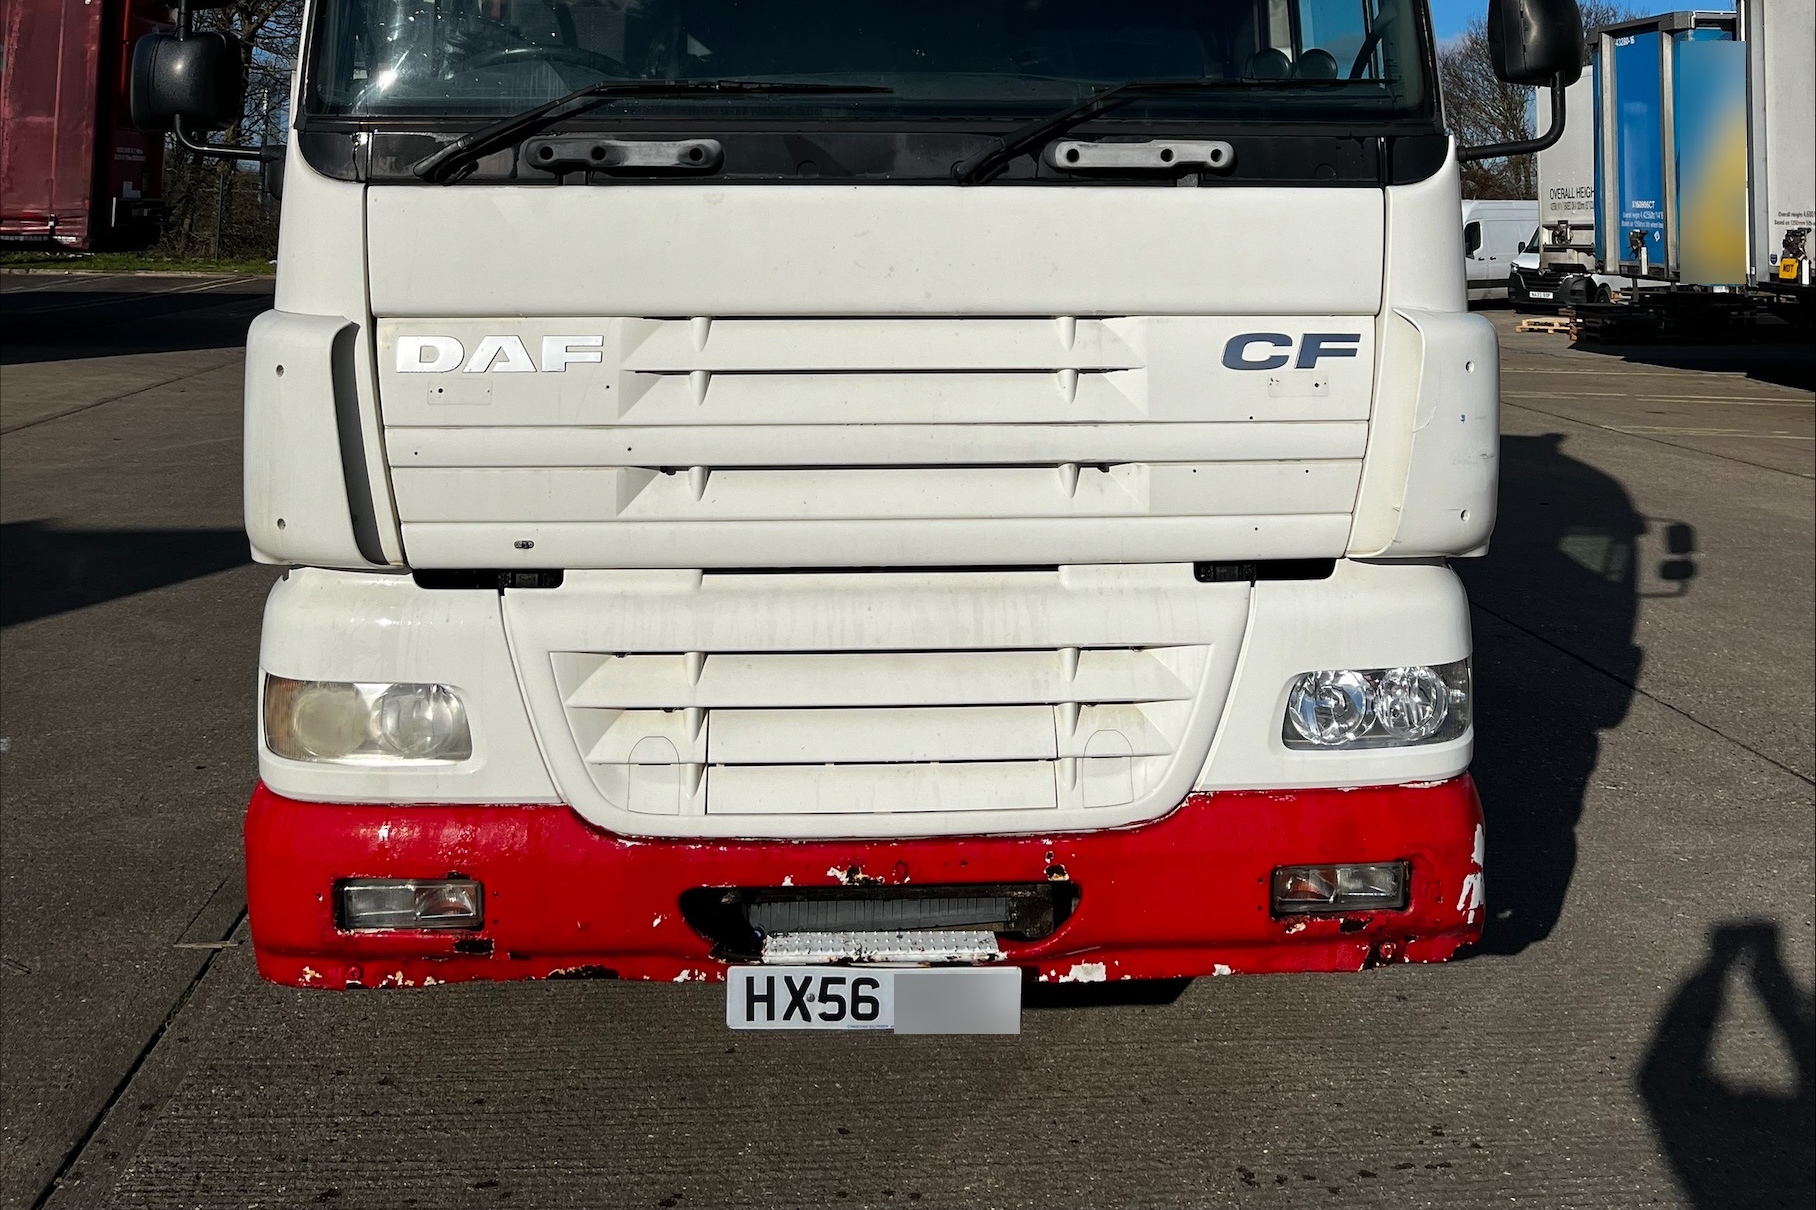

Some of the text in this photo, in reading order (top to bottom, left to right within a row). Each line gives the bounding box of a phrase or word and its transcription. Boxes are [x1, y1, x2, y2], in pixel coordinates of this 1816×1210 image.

[1550, 187, 1576, 200] OVERALL
[396, 335, 604, 373] DAF
[1221, 333, 1361, 371] CF
[745, 976, 880, 1022] HX56
